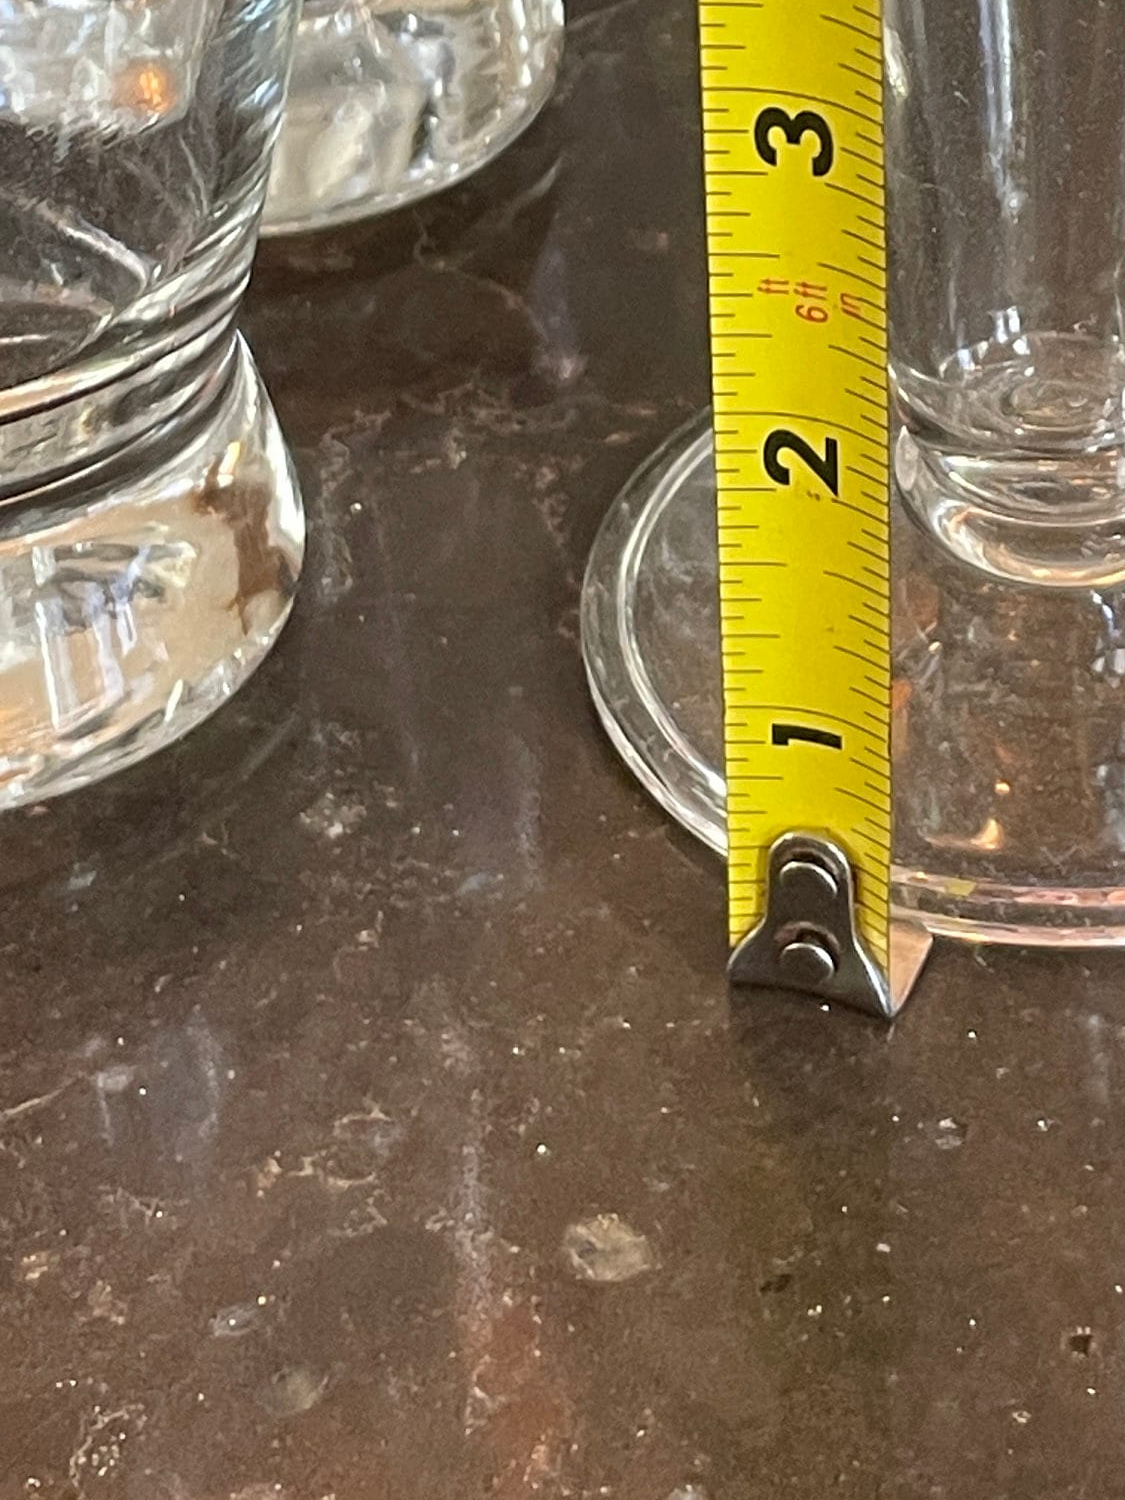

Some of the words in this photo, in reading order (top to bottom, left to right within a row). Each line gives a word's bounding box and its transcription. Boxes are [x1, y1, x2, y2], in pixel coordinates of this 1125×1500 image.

[754, 107, 834, 177] 3
[763, 429, 838, 497] 2
[772, 723, 842, 751] 1
